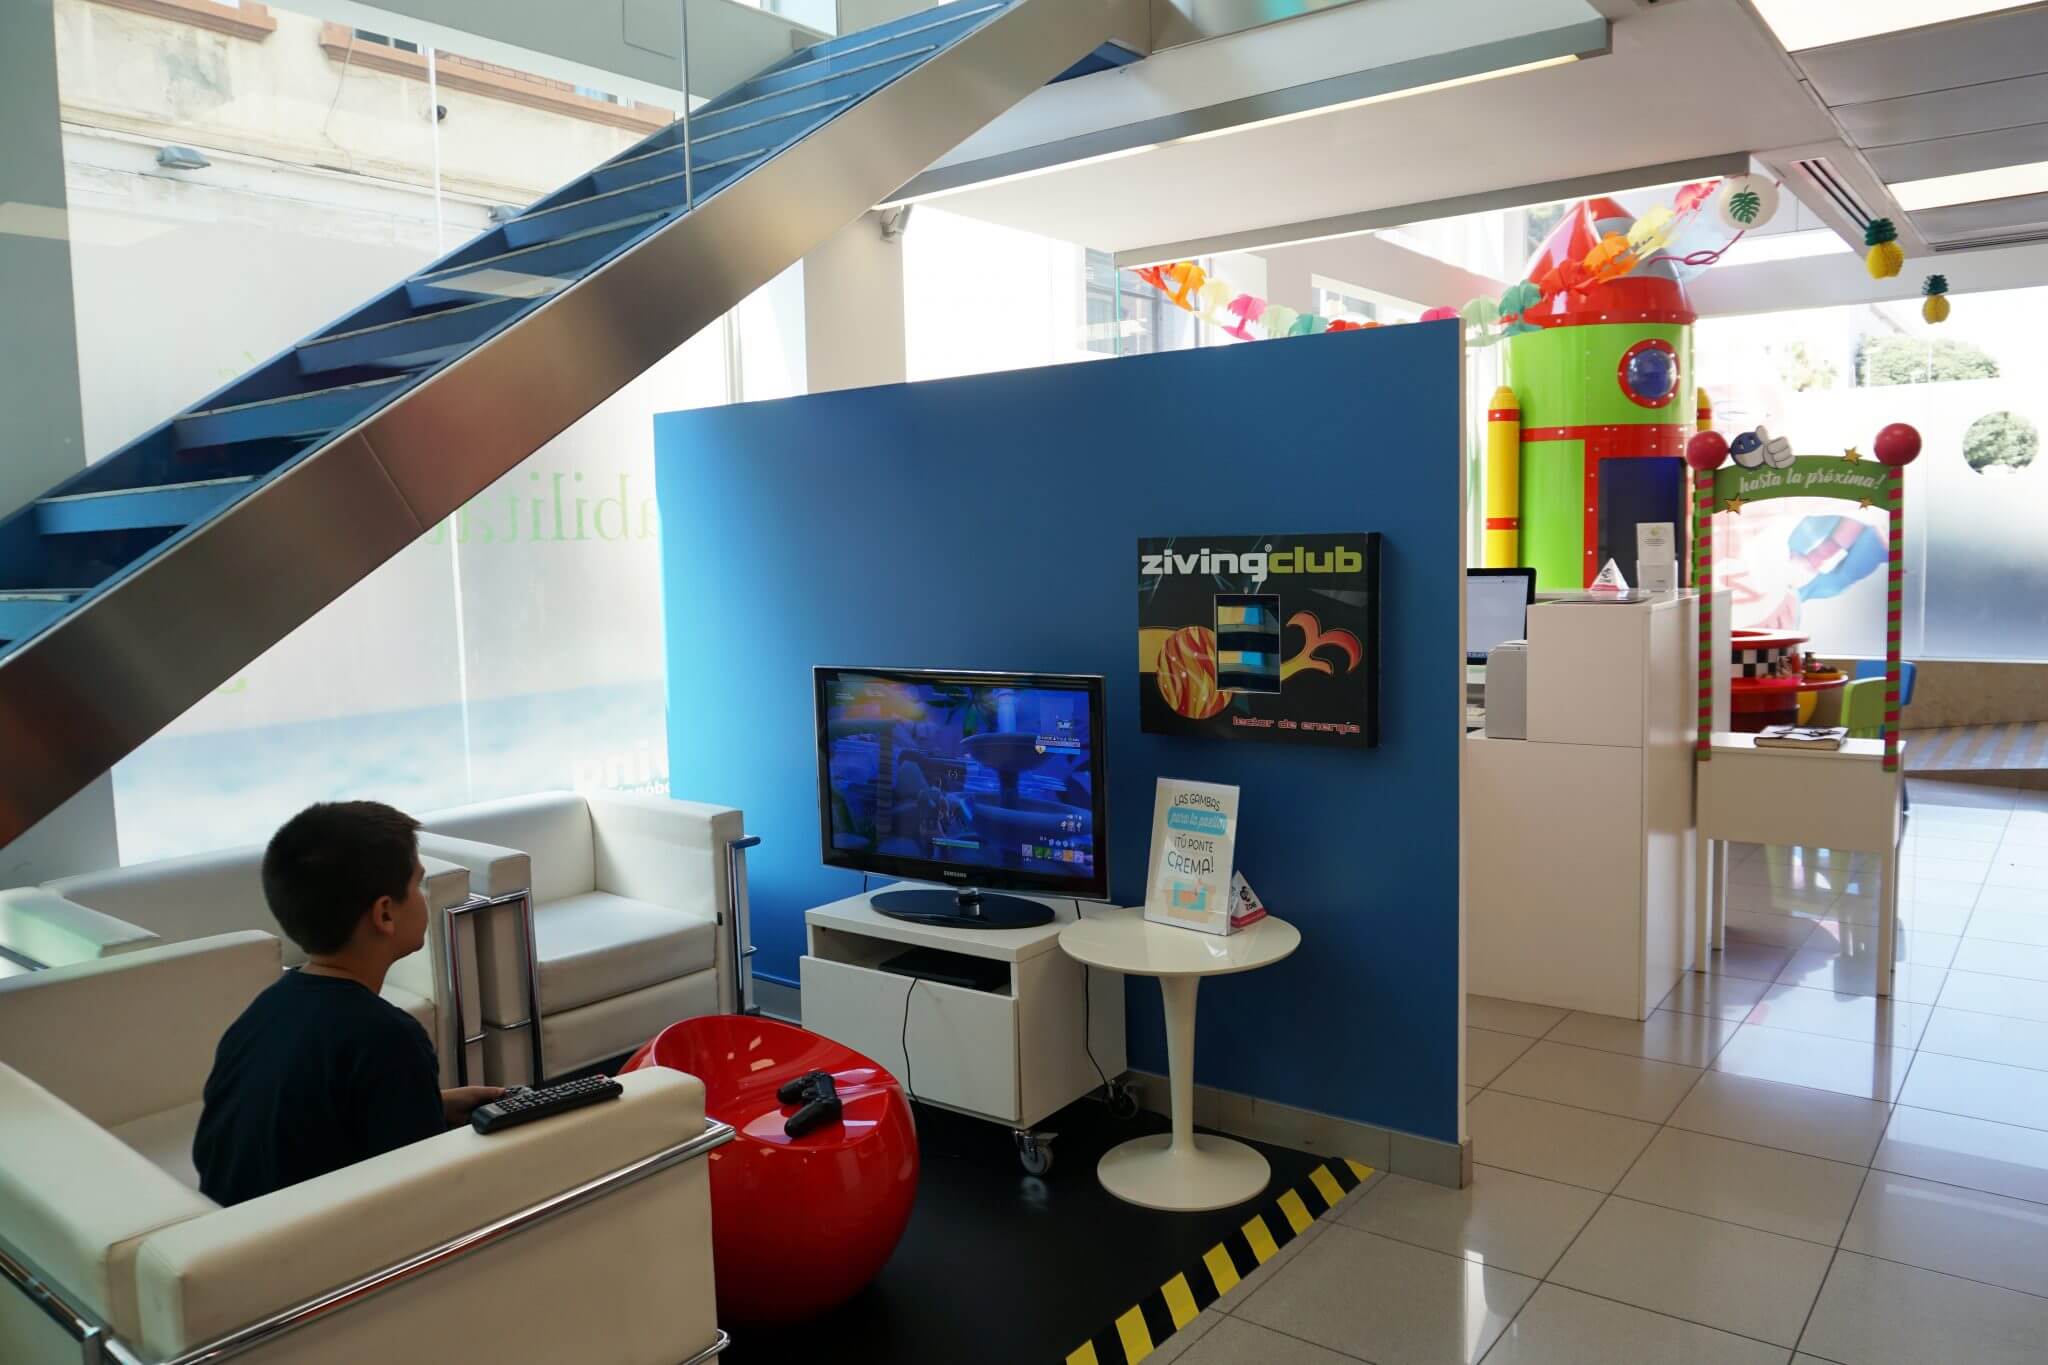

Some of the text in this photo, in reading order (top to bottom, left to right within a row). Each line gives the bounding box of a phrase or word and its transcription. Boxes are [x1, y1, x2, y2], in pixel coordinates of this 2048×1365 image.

[1739, 470, 1781, 493] hasta
[1786, 468, 1802, 485] la
[1278, 719, 1297, 730] de
[1188, 838, 1214, 854] PONTE
[1167, 850, 1215, 875] CREMA!
